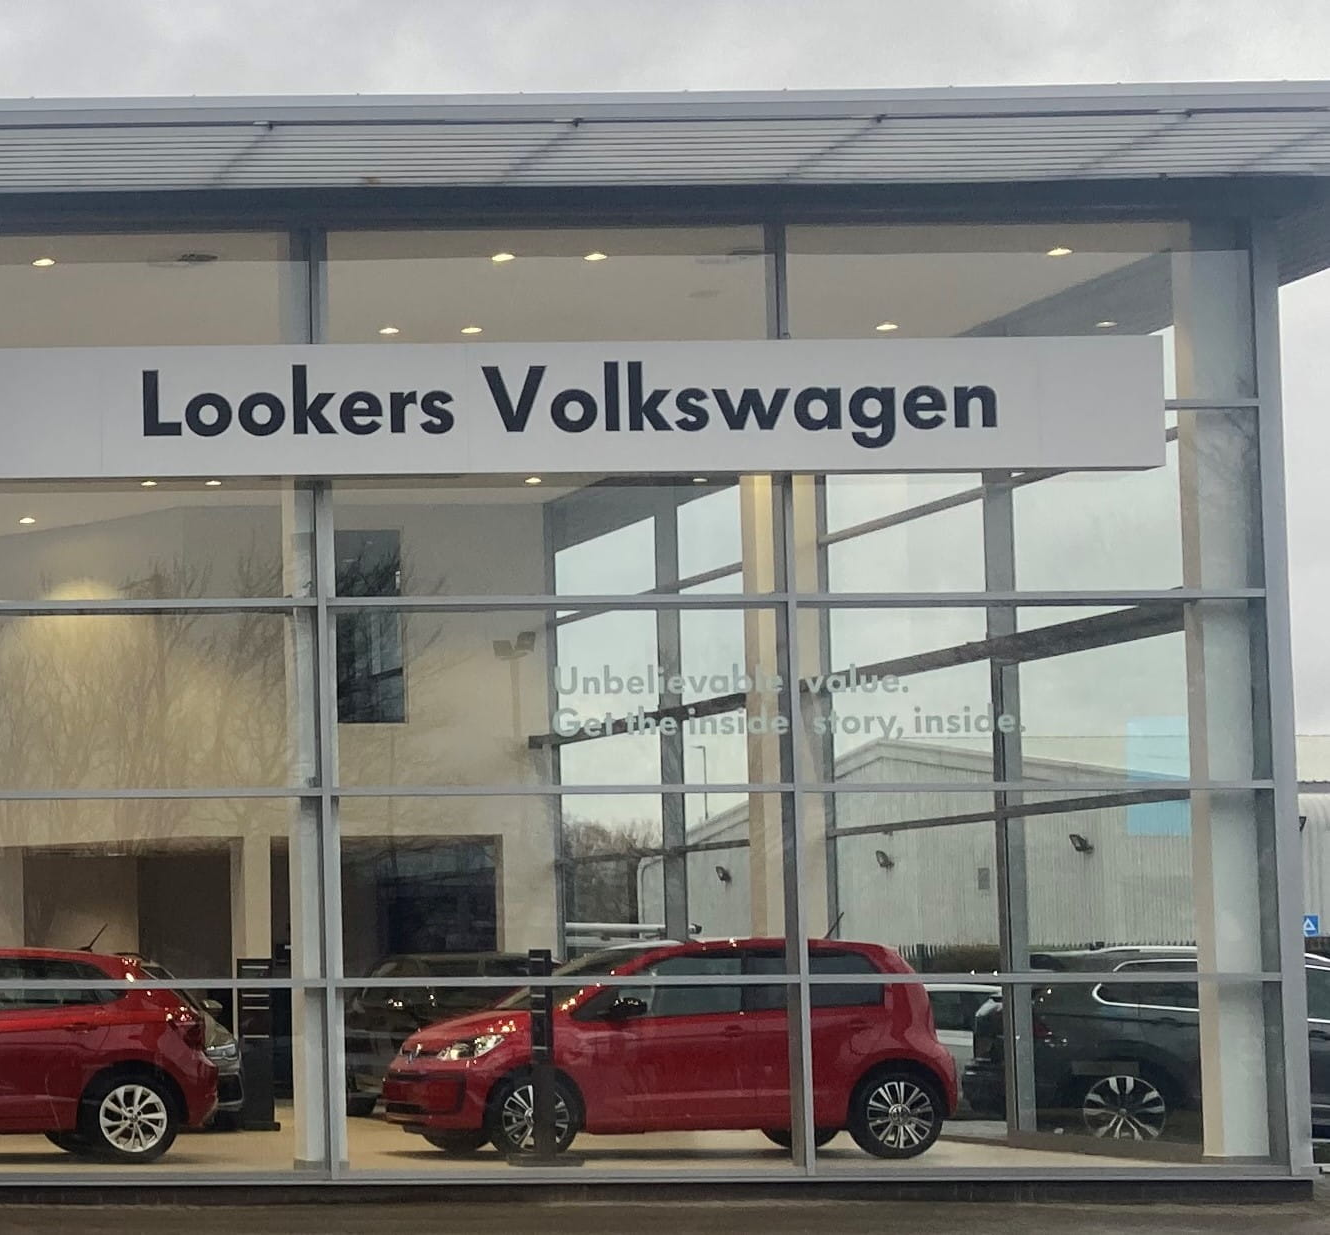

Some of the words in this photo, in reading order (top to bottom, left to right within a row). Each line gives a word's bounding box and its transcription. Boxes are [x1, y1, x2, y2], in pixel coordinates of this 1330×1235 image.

[142, 364, 455, 437] Lookers
[481, 360, 998, 449] Volkswagen
[555, 663, 785, 694] Unbelievable
[805, 664, 909, 693] value.
[552, 707, 616, 737] Get
[625, 705, 678, 735] the
[687, 704, 789, 735] inside
[813, 708, 903, 739] story,
[914, 703, 1026, 734] inside.
